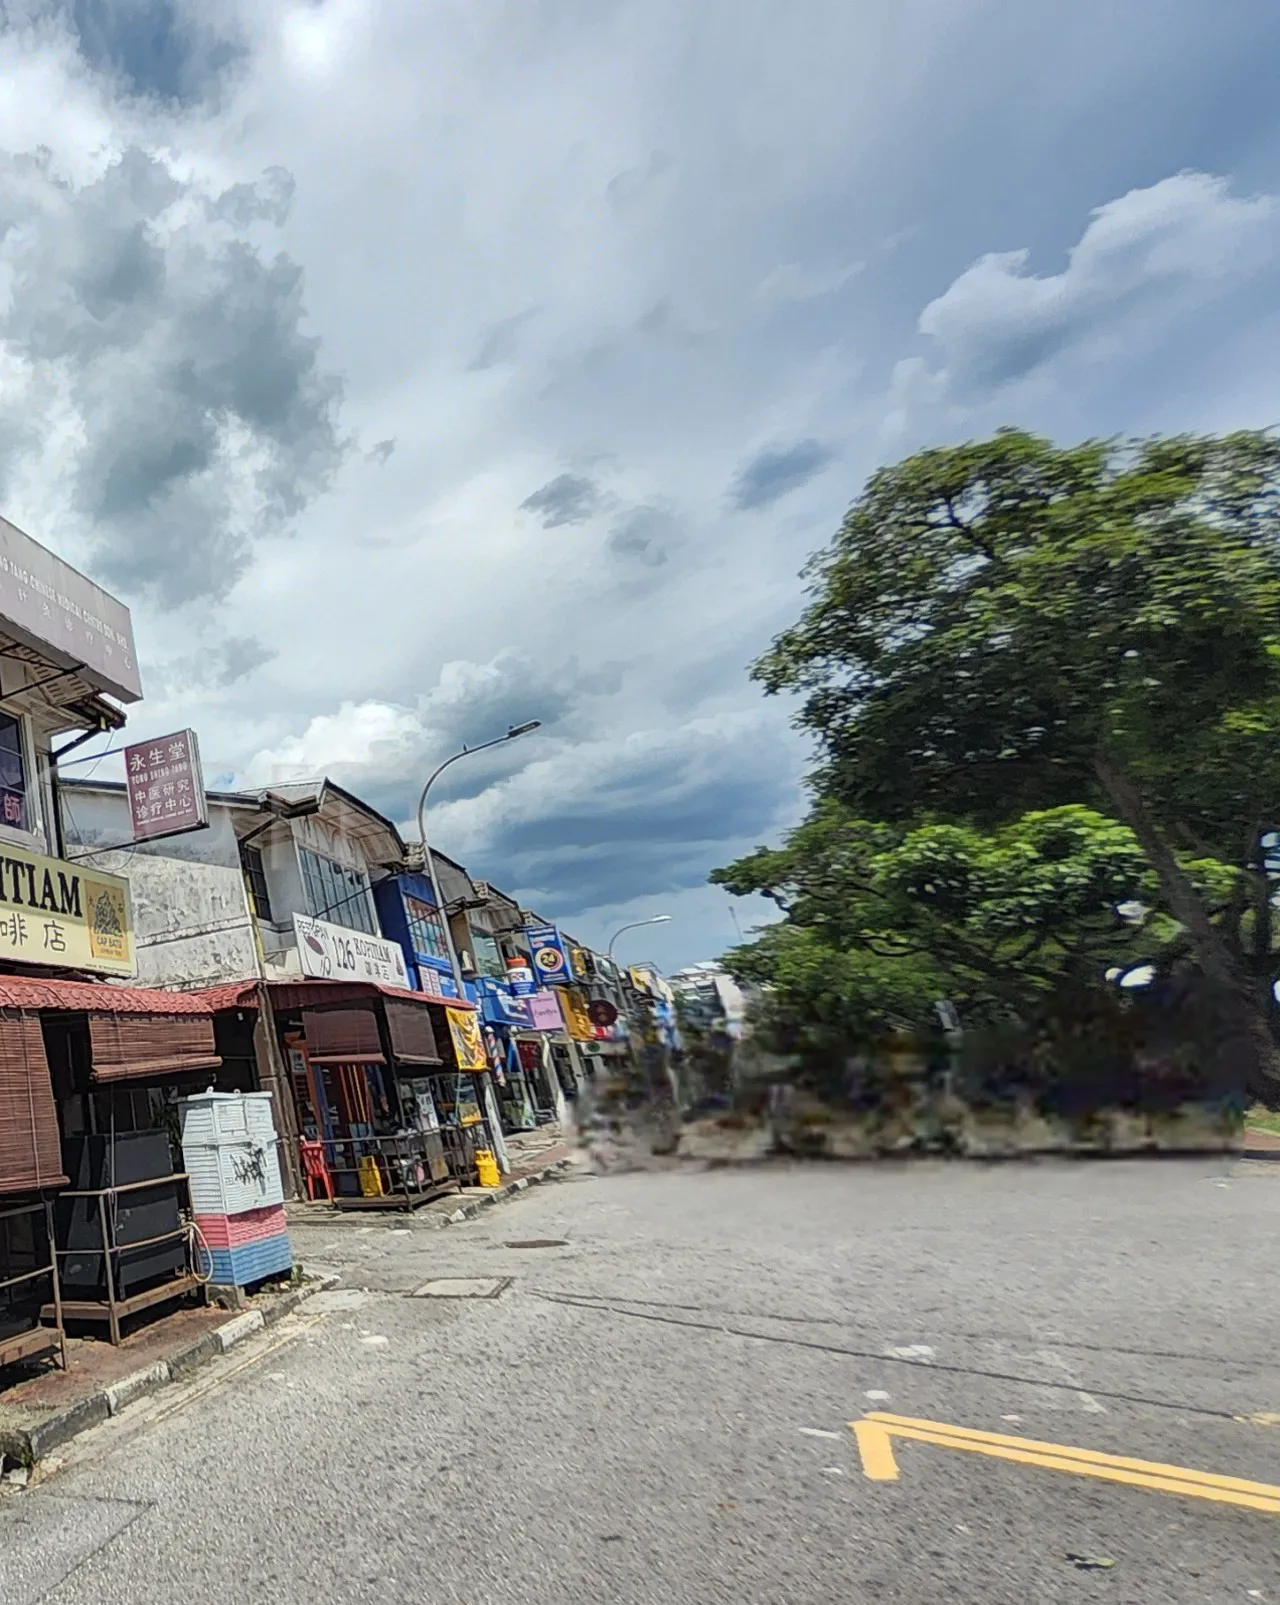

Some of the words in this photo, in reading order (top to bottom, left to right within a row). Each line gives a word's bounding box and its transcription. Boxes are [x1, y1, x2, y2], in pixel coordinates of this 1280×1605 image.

[130, 741, 187, 773] 永生堂
[135, 778, 191, 804] 中医研究
[136, 794, 192, 819] 诊疗中心
[331, 935, 356, 972] 126
